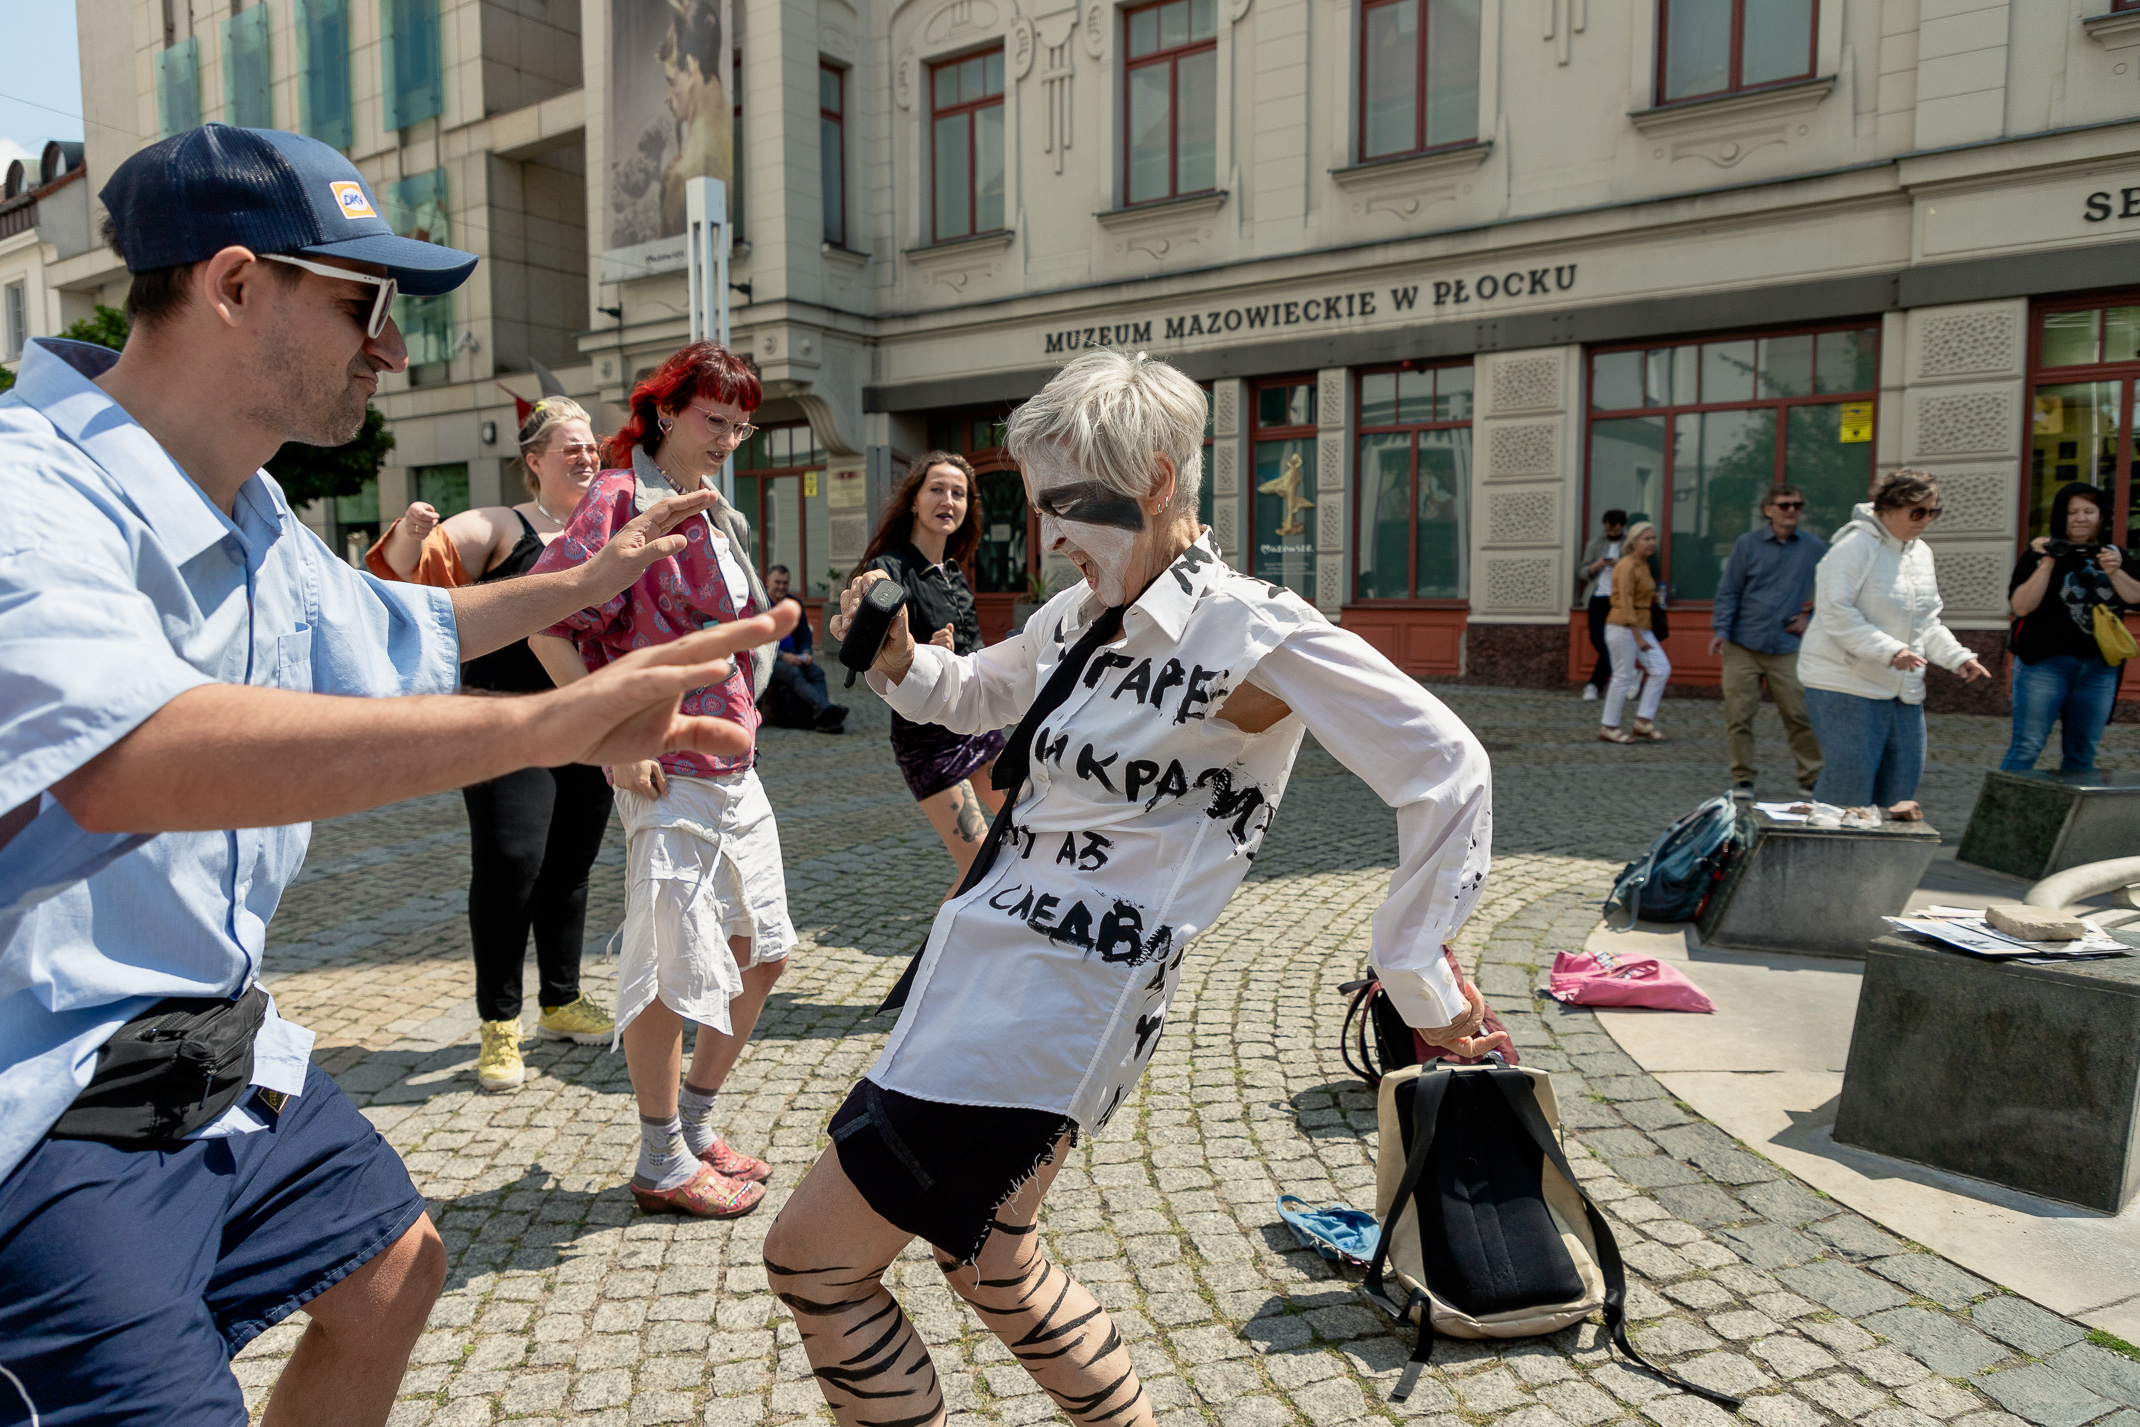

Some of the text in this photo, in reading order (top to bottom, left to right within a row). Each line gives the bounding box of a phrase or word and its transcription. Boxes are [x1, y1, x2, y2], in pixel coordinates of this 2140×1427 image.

[1045, 264, 1577, 353] MUZEUM MAZOWIECKIE W PŁOCKU
